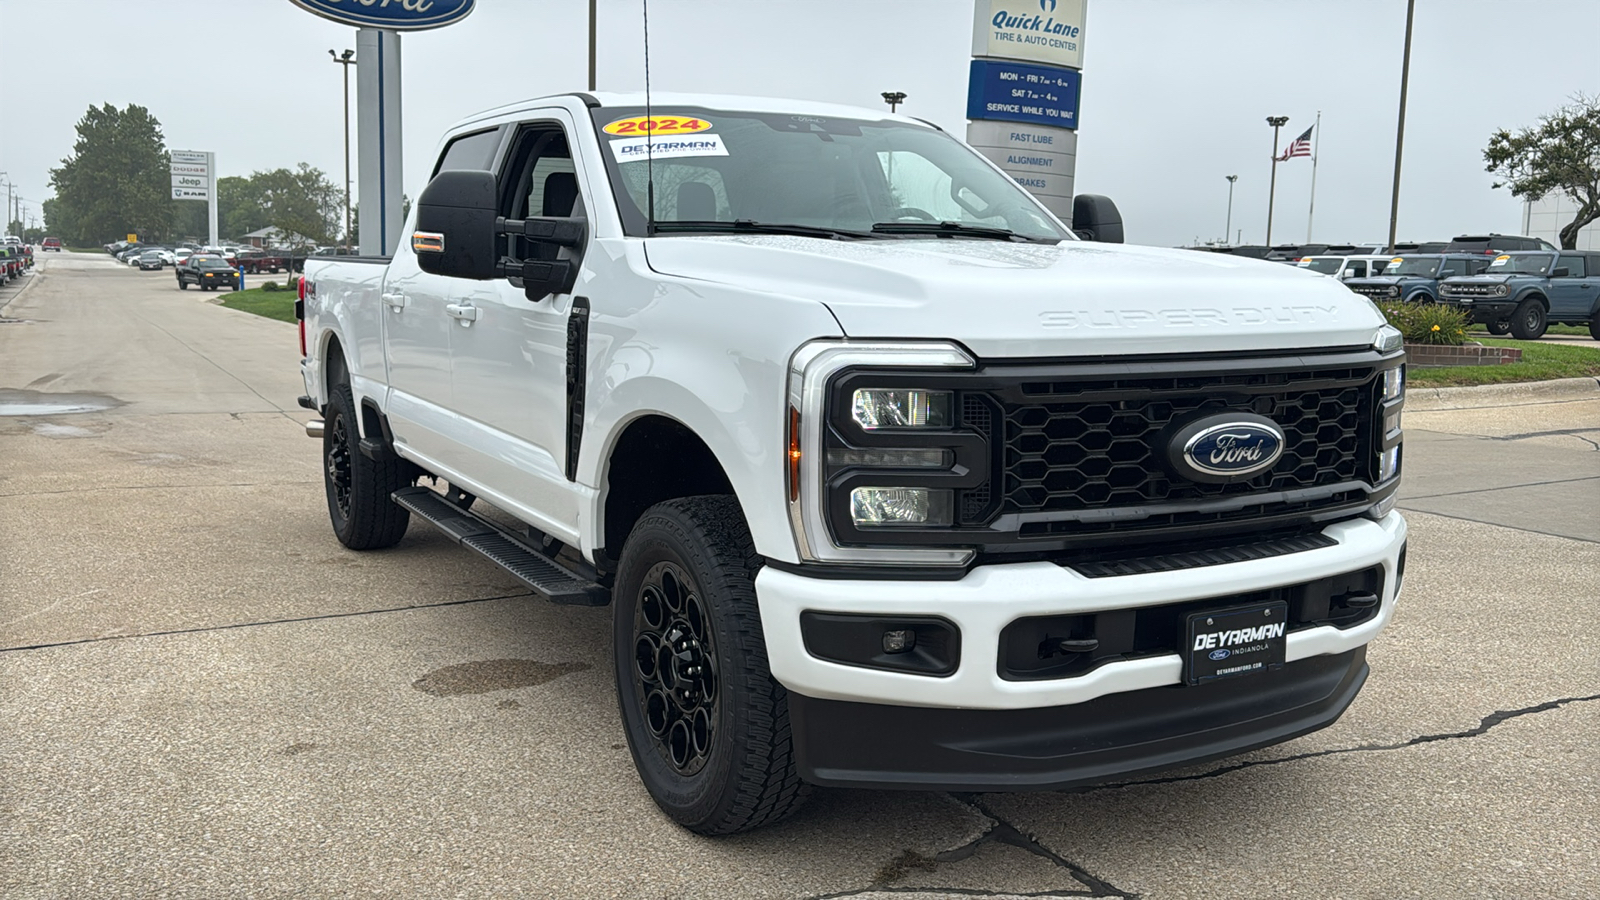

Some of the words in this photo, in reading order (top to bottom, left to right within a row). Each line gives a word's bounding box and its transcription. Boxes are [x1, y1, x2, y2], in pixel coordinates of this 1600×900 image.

[992, 10, 1043, 31] Quick
[1043, 17, 1079, 38] Lane
[994, 31, 1015, 42] TIRE
[1016, 34, 1023, 43] &
[1024, 35, 1048, 46] AUTO
[1048, 38, 1077, 52] CENTER
[1000, 72, 1018, 81] MON
[1026, 74, 1038, 84] FRI
[1011, 88, 1026, 97] SAT
[986, 102, 1020, 113] SERVICE
[1021, 105, 1043, 115] WHILE
[1045, 108, 1059, 117] YOU
[1060, 110, 1074, 119] WAIT
[616, 119, 702, 134] 2024
[1010, 132, 1031, 142] FAST
[1032, 134, 1054, 145] LUBE
[621, 141, 717, 154] DEYARMAN
[1007, 155, 1054, 167] ALIGNMENT
[179, 177, 201, 187] Jeep
[1038, 307, 1229, 330] SUPER
[1232, 305, 1339, 325] DUTY
[1210, 433, 1264, 465] Ford
[1193, 622, 1286, 651] DEYARMAN
[1231, 643, 1269, 656] INDIANOLA
